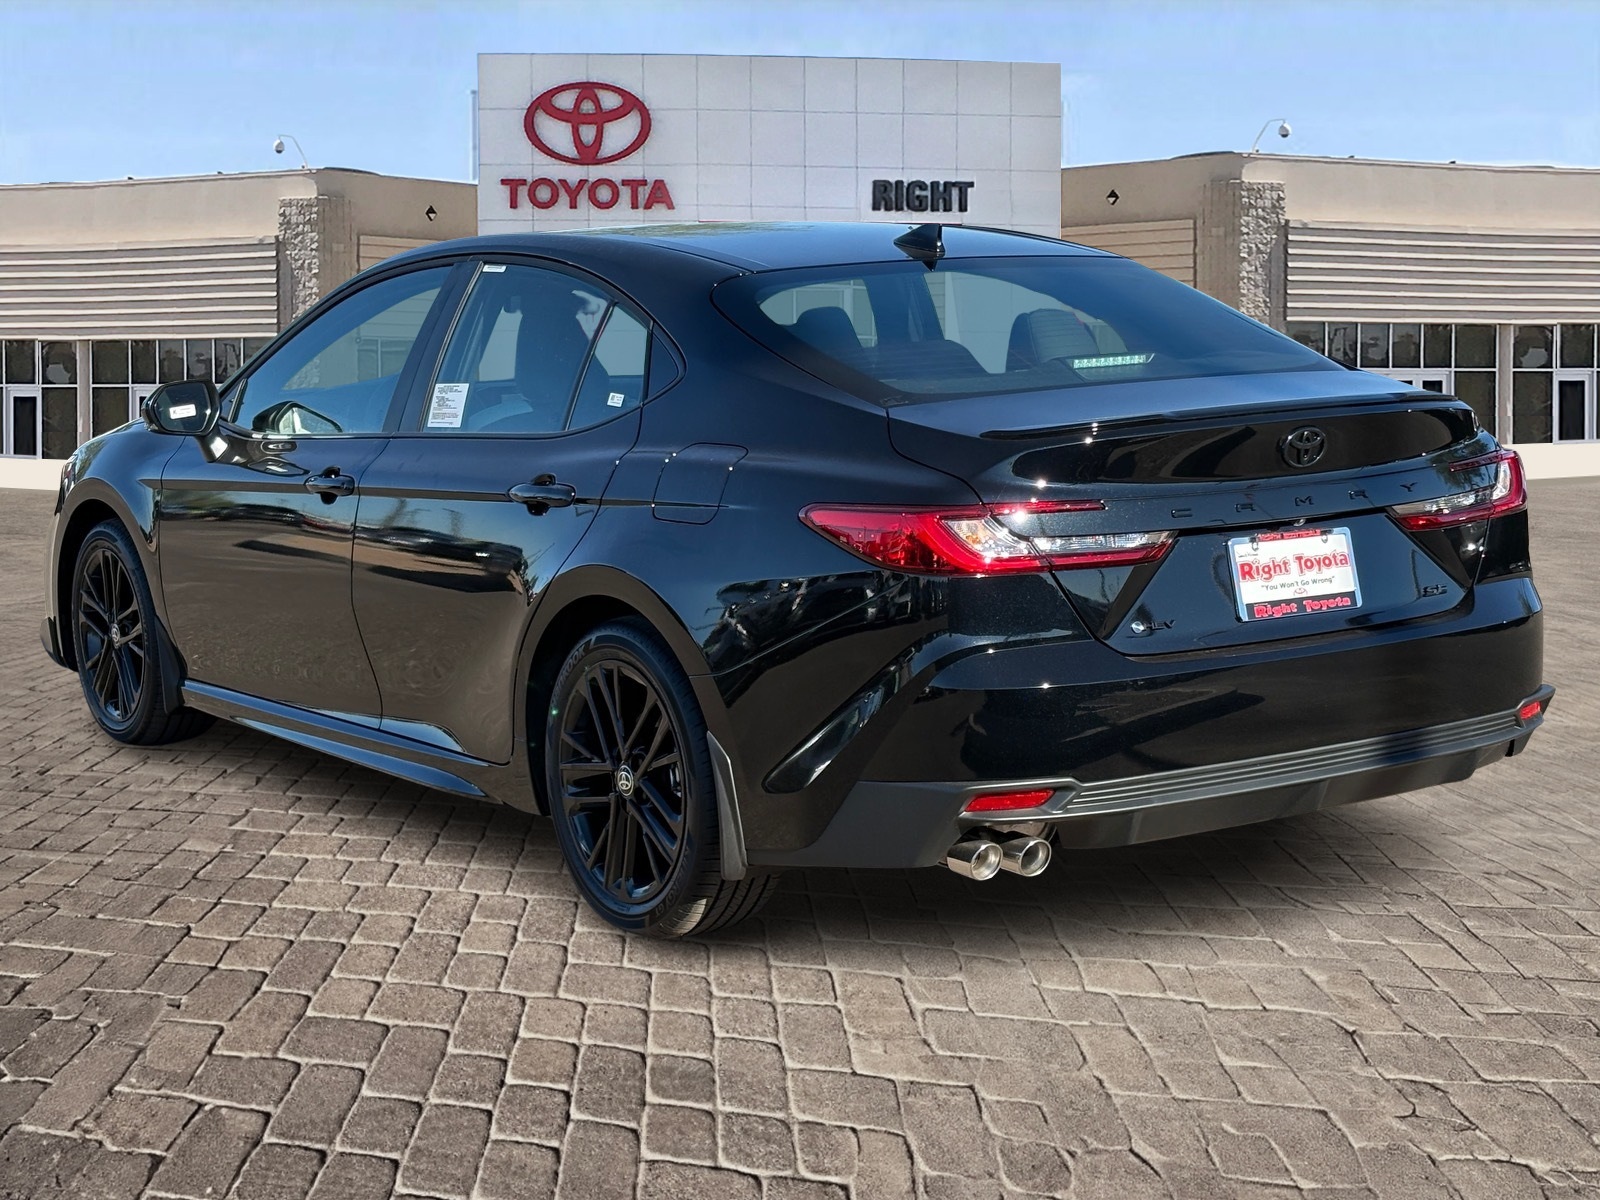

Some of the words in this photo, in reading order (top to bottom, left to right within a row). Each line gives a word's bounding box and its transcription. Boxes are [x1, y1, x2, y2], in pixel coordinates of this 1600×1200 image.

[501, 178, 675, 211] TOYOTA
[871, 179, 975, 213] RIGHT
[1171, 481, 1418, 519] CAMRY
[1238, 557, 1291, 581] Right
[1294, 551, 1350, 575] Toyota
[1300, 579, 1310, 587] Go
[1422, 584, 1448, 597] SE
[1253, 603, 1297, 618] Right
[1303, 597, 1351, 613] Toyota
